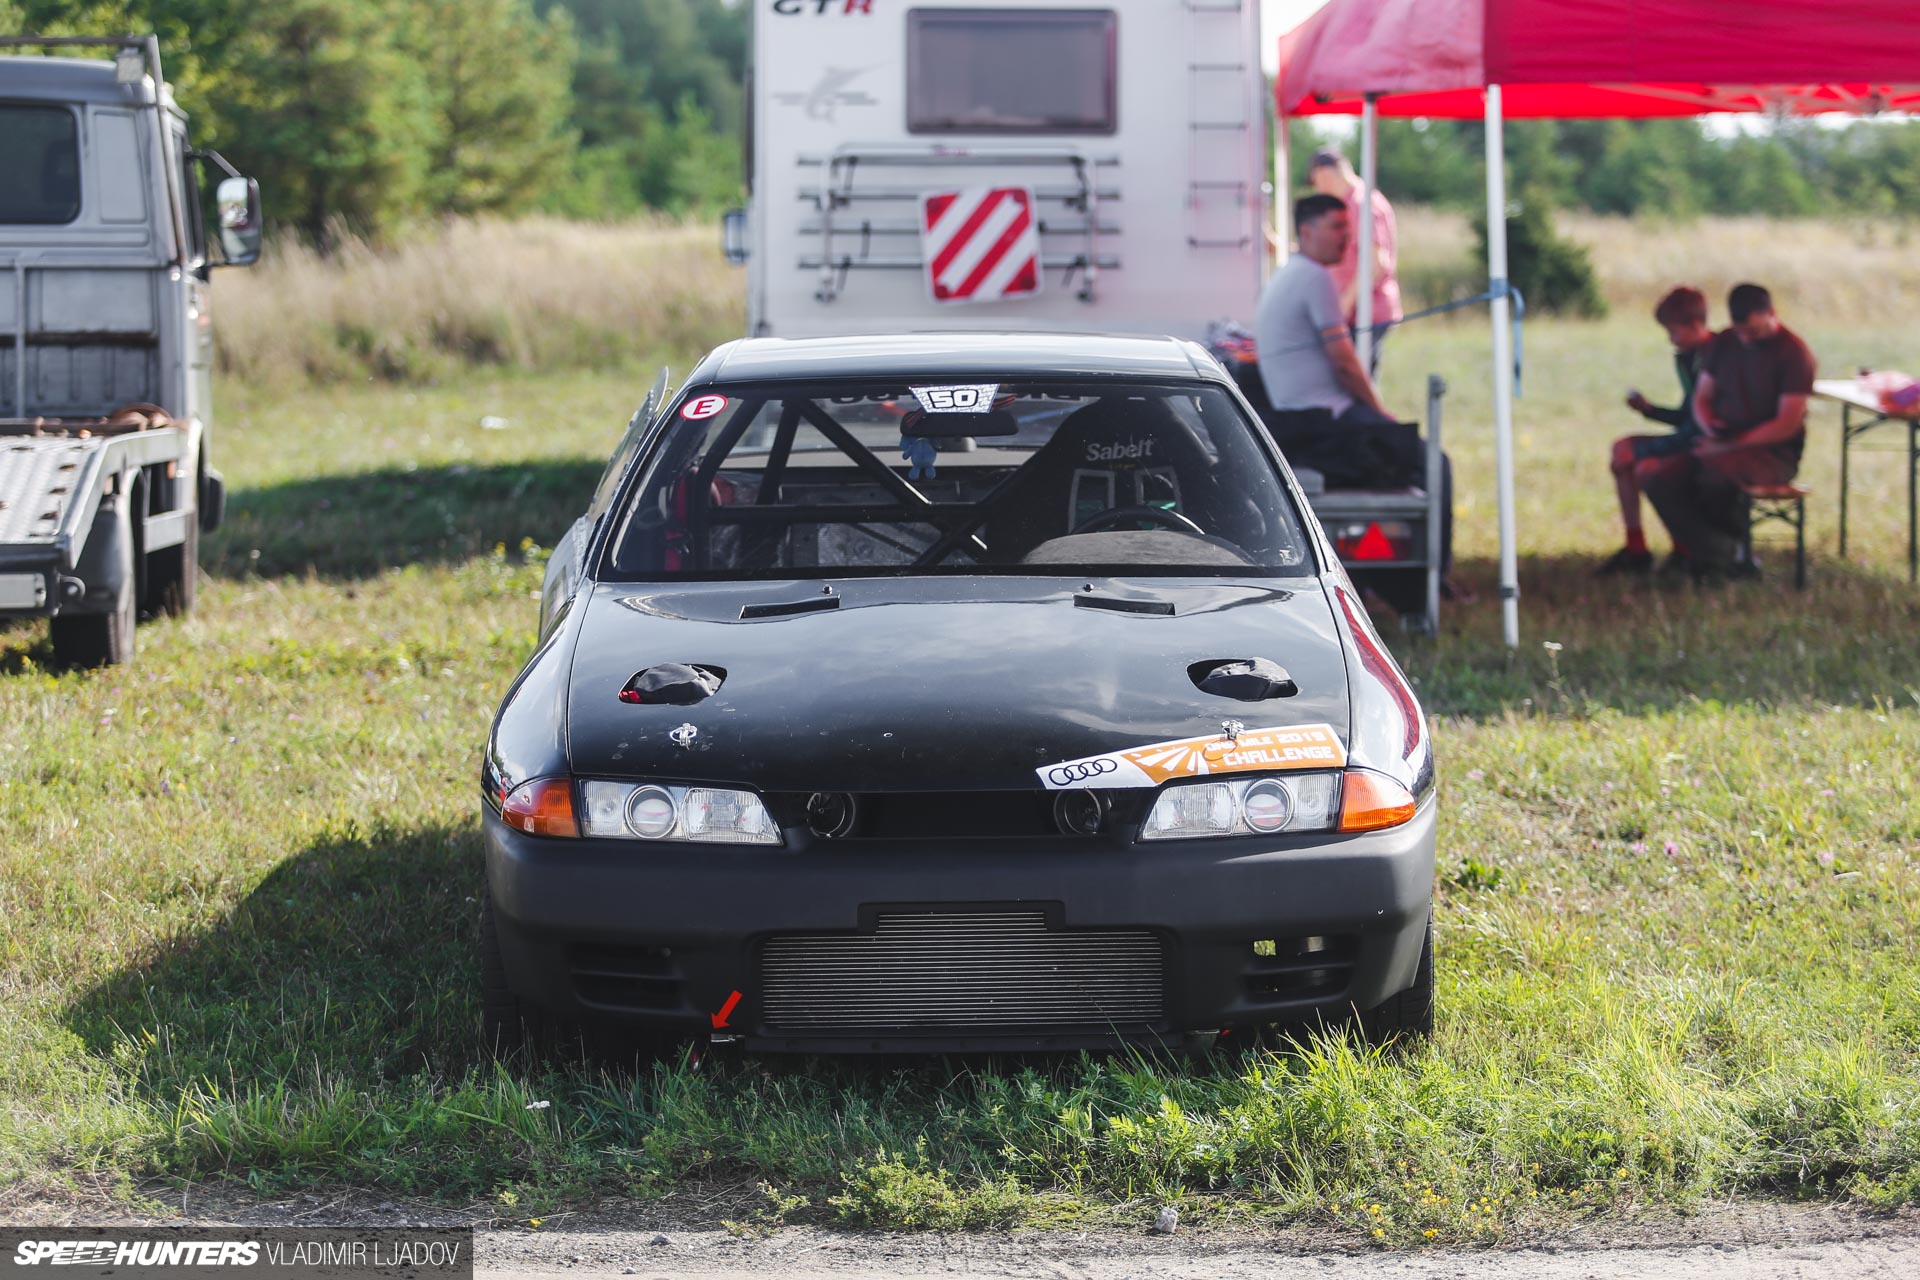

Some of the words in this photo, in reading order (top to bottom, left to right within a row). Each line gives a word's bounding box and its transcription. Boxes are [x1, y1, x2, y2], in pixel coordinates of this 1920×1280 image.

[693, 399, 716, 415] E
[927, 389, 978, 409] 50
[1086, 439, 1153, 461] Sabelt
[1238, 736, 1274, 747] MILE
[1223, 746, 1335, 766] CHALLENGE
